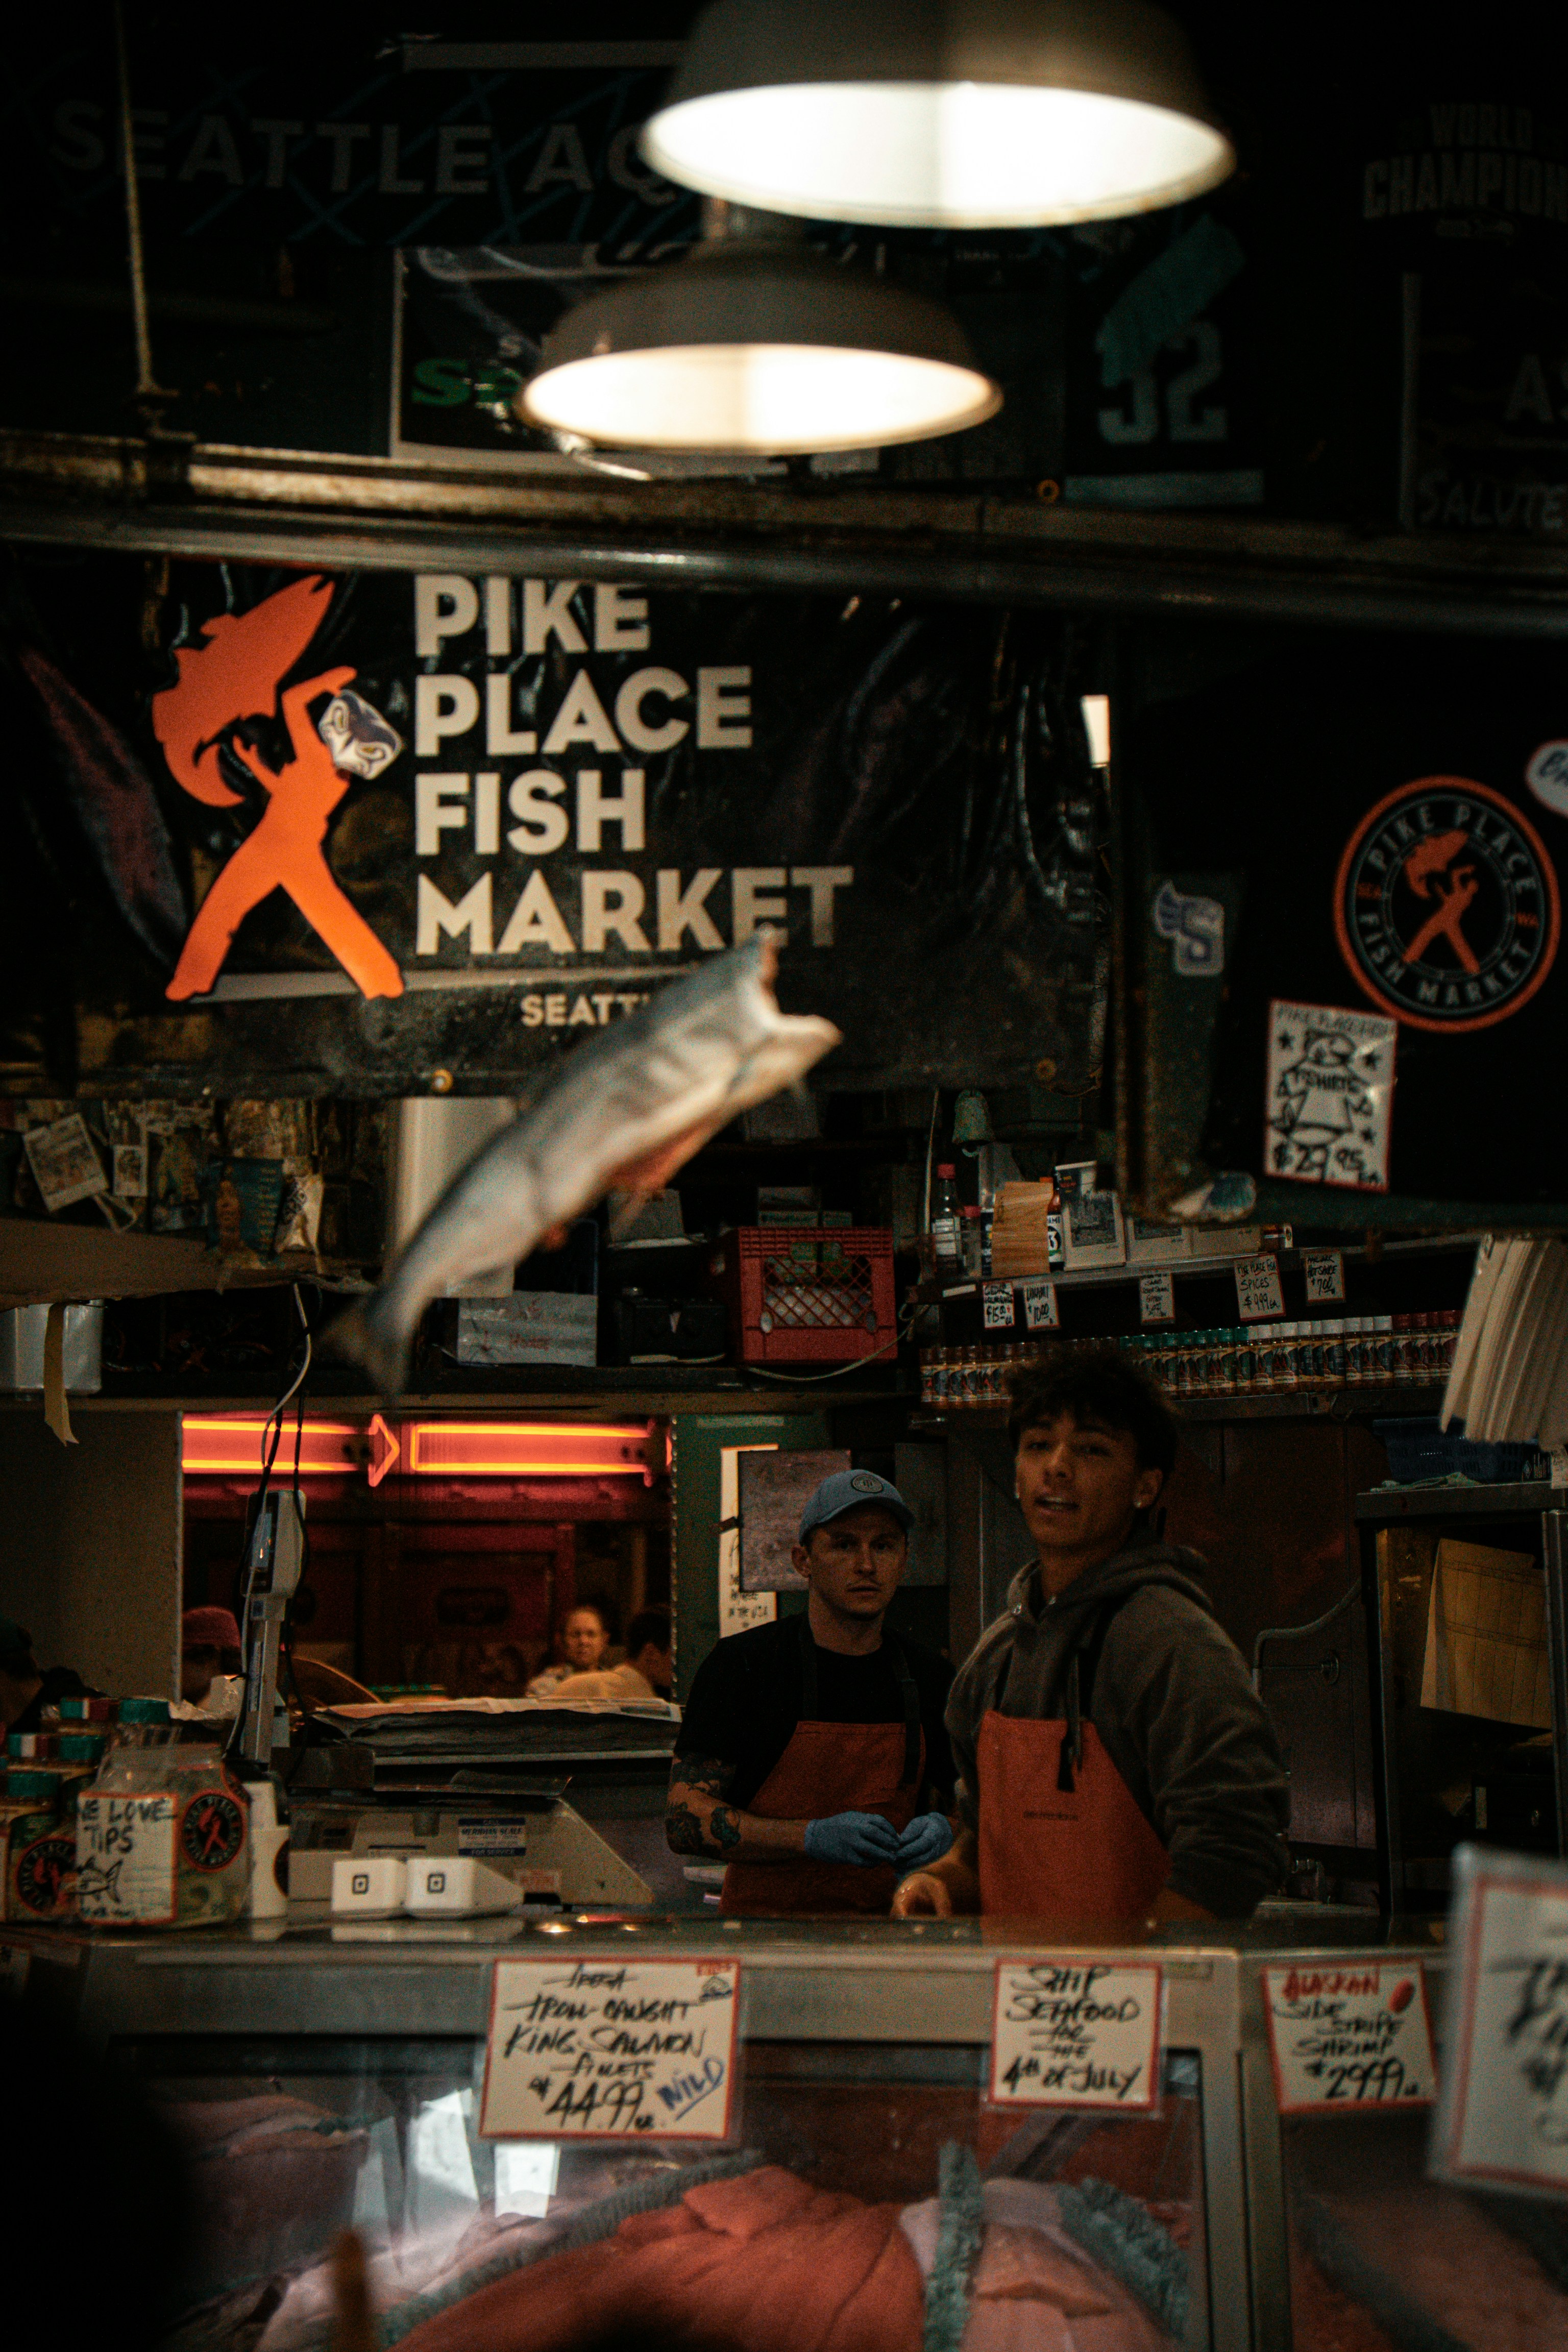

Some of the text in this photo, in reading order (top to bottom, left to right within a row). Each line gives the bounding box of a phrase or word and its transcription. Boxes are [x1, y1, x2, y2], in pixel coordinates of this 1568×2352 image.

[48, 97, 678, 205] SEATTLE AQ
[1429, 102, 1533, 152] WORLD
[413, 573, 651, 658] PIKE
[414, 665, 753, 757] PLACE
[414, 768, 646, 856] FISH
[1366, 802, 1538, 895] PIKE PLACE
[415, 864, 854, 955] MARKET
[1358, 911, 1532, 1007] FISH MARKET
[520, 993, 650, 1027] SEATT
[1240, 1277, 1270, 1291] SPICES
[109, 1797, 178, 1823] LOVE
[84, 1825, 133, 1854] TIPS
[1010, 1965, 1112, 1996] SHIP
[1006, 1994, 1141, 2023] SEAFOOD
[504, 2023, 706, 2059] KING SALMON
[657, 2056, 725, 2112] WILD
[1071, 2062, 1142, 2100] JULY
